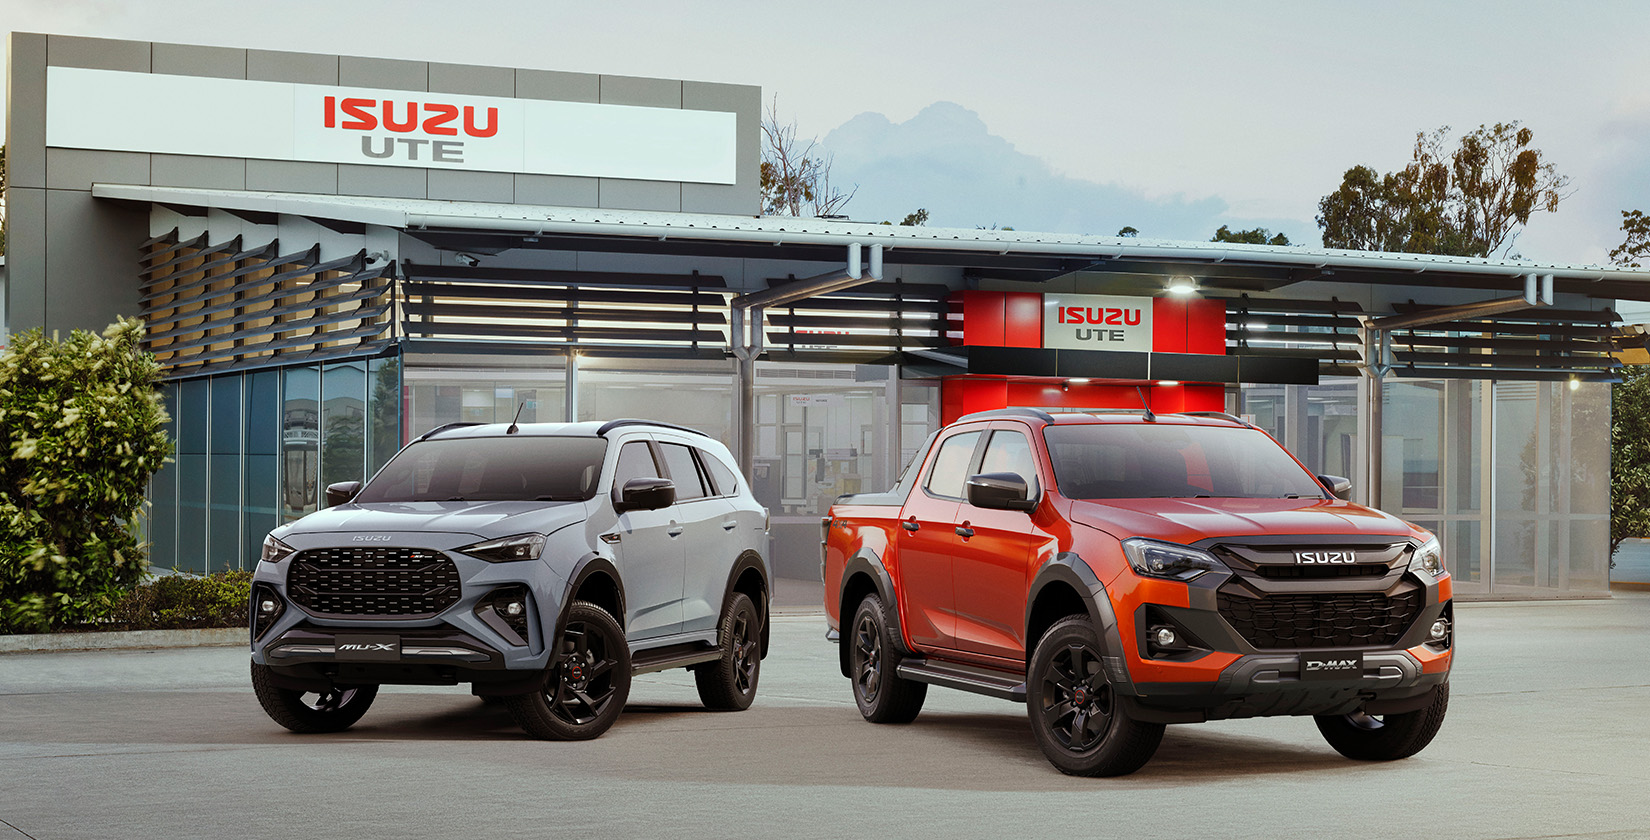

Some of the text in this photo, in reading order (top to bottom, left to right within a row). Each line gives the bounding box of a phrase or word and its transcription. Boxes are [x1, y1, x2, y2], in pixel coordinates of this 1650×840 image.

[324, 96, 498, 138] ISUZU
[361, 135, 465, 163] UTE
[1058, 306, 1141, 326] ISUZU
[1075, 328, 1125, 342] UTE
[1295, 552, 1356, 564] ISUZU
